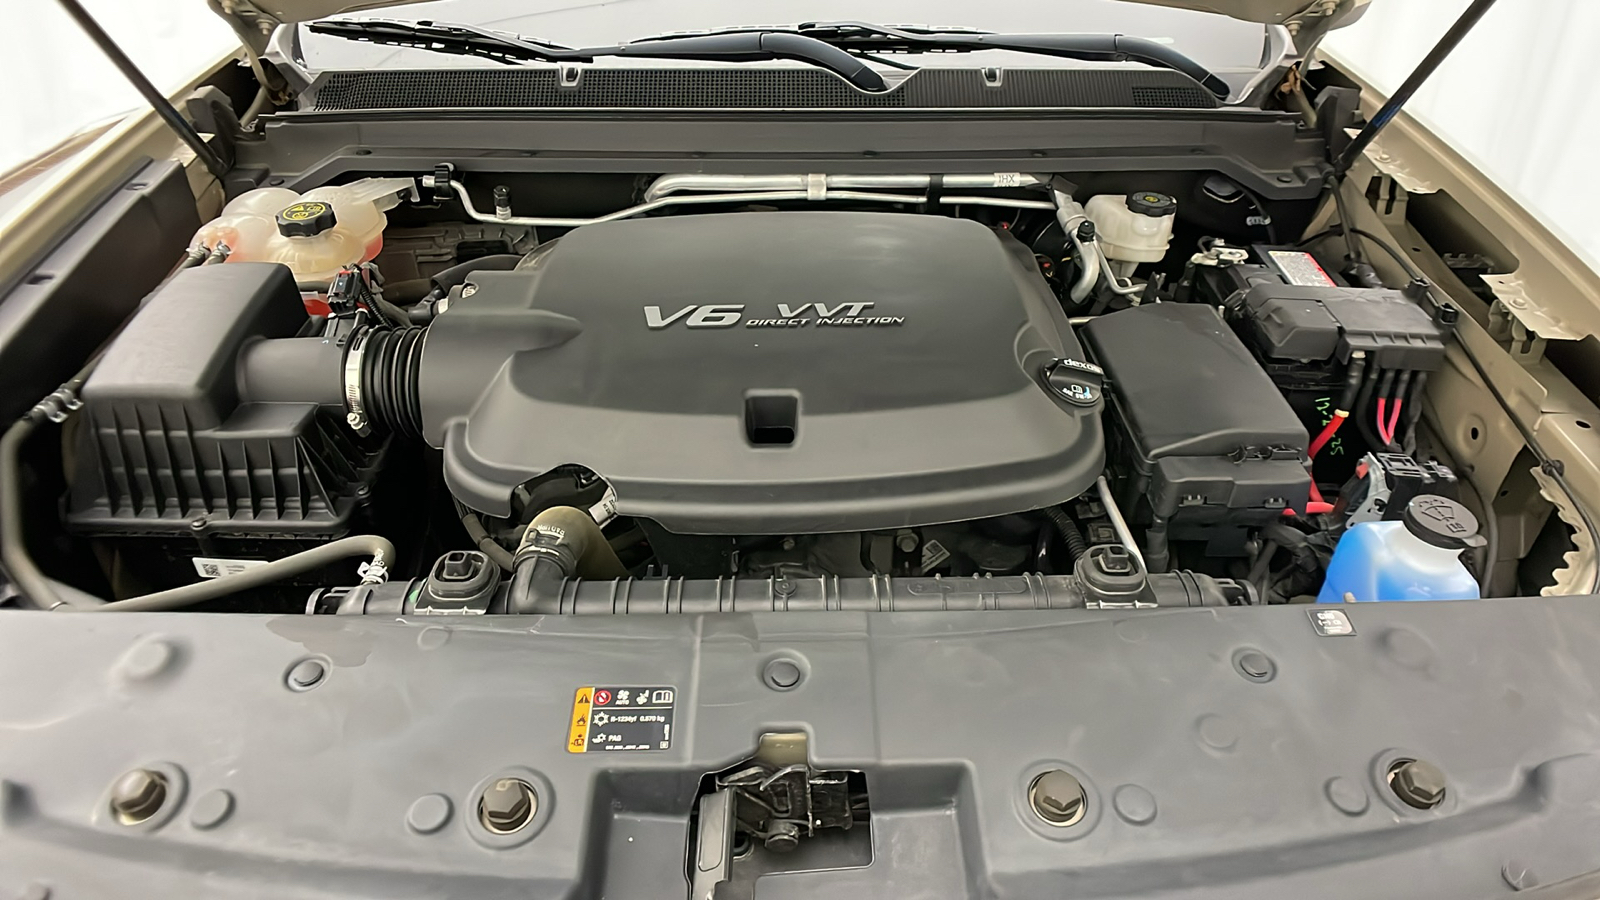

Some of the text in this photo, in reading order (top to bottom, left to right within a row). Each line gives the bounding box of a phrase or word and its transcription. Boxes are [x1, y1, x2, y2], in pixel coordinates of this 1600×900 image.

[777, 302, 875, 317] VVT
[643, 304, 746, 328] V6
[746, 316, 905, 326] DIRECT INJECTION
[608, 734, 622, 742] PAG
